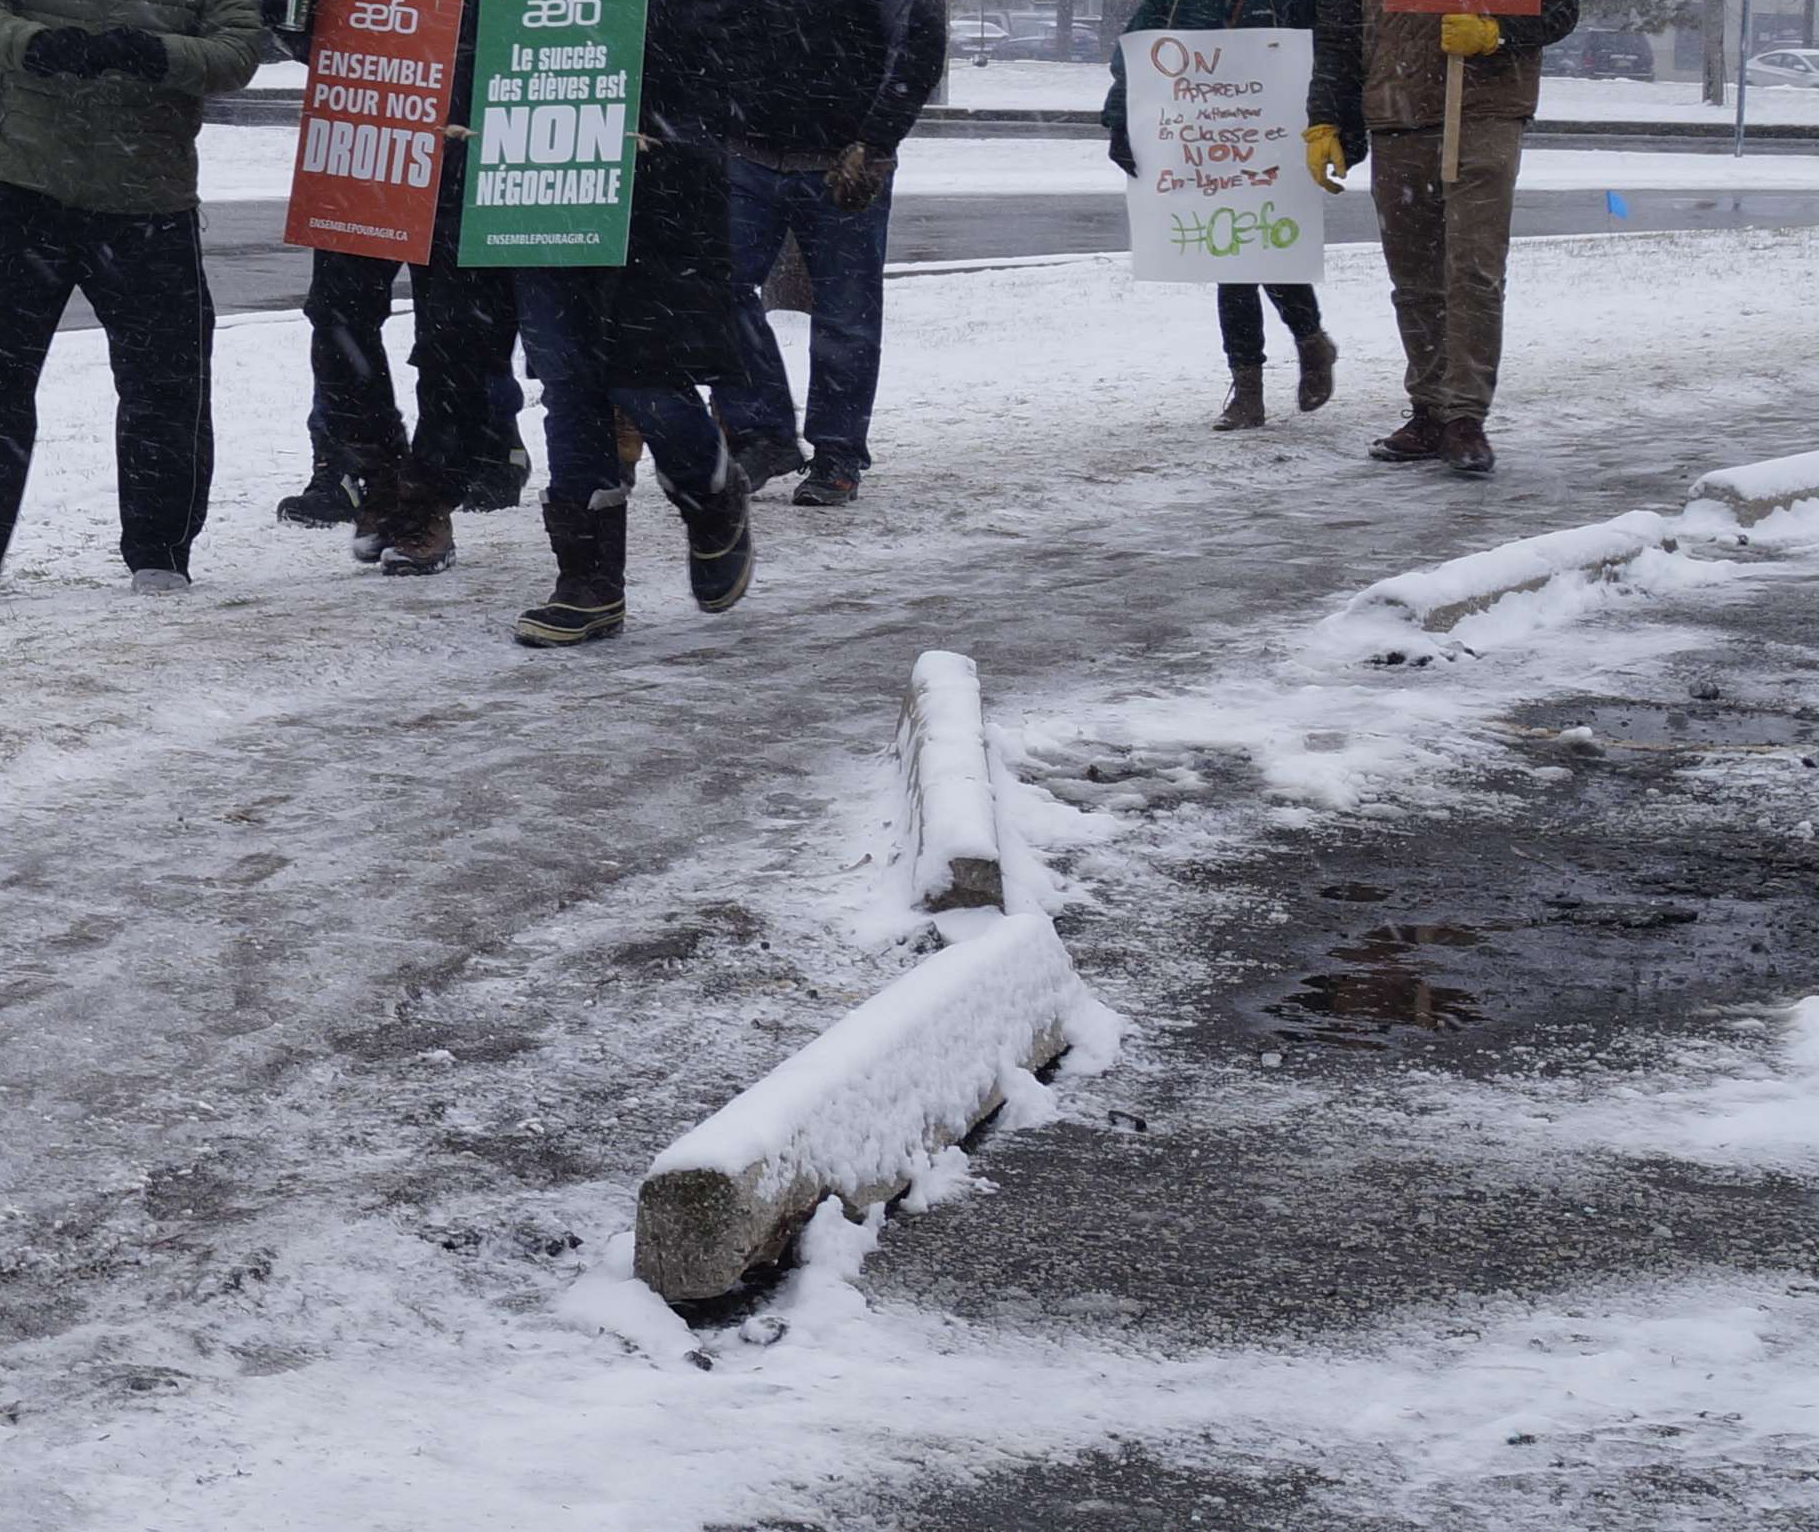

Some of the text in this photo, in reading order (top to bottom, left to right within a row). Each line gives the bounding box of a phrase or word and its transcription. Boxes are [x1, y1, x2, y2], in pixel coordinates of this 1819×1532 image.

[317, 49, 444, 90] ENSEMBLE
[512, 41, 607, 71] Le succès
[313, 83, 438, 123] POUR NOS
[488, 70, 627, 102] des élèves est
[480, 104, 626, 165] NON
[302, 119, 436, 189] DROITS
[1183, 144, 1254, 166] NON
[476, 165, 621, 206] NÉGOCIABLE
[309, 217, 409, 242] ENSEMBLEPOURAGIR.CA
[486, 233, 600, 246] ENSEMBLEPOURAGIR.CA
